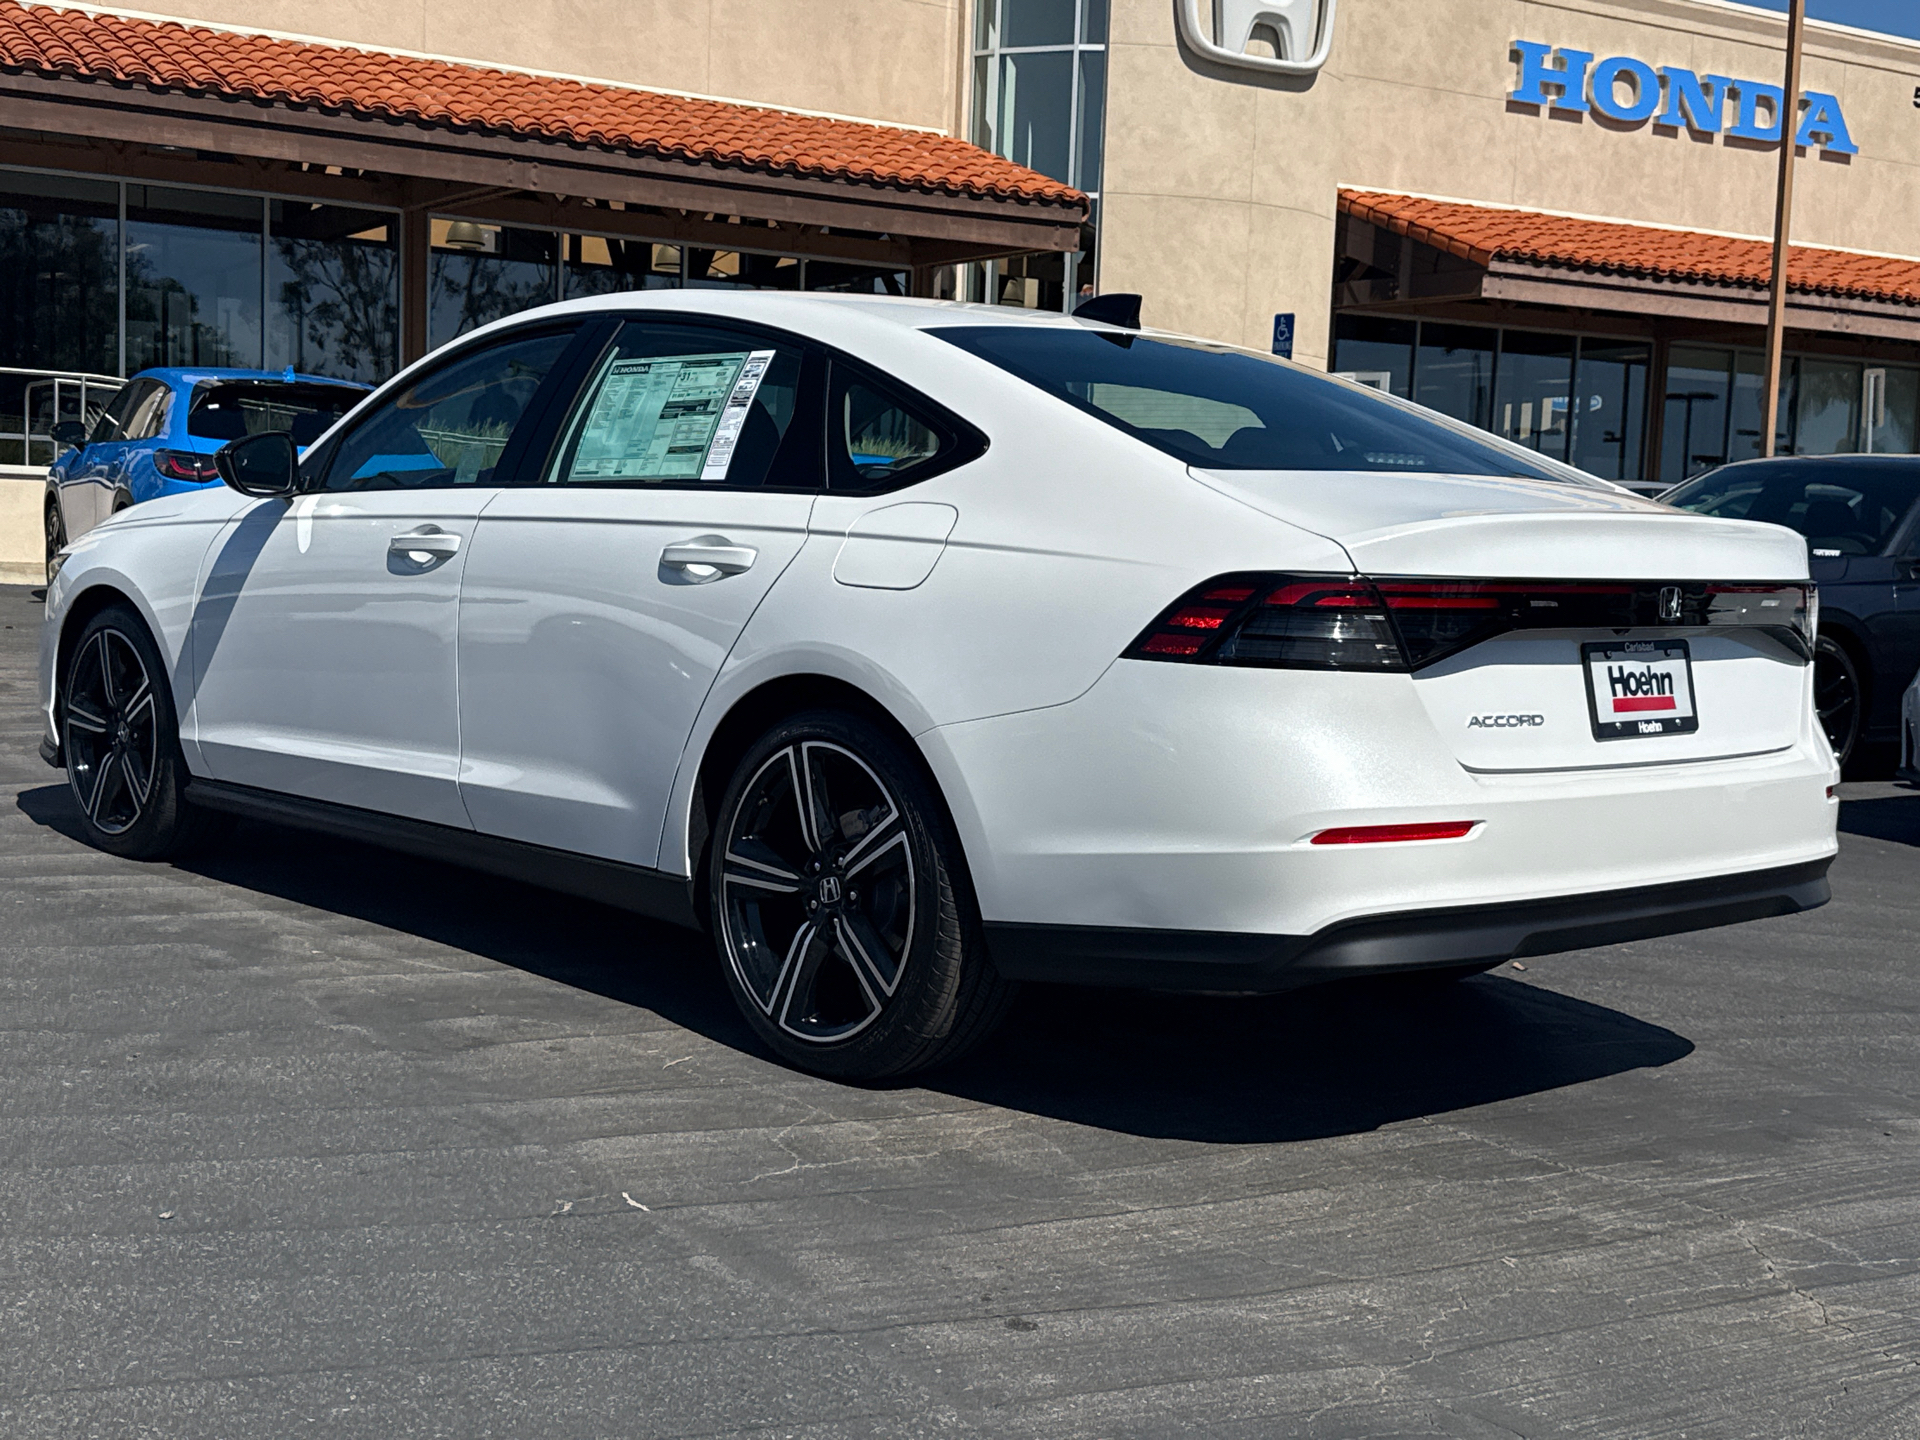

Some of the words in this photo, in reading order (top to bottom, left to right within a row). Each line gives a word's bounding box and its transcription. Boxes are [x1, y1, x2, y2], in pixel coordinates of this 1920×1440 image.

[1507, 39, 1859, 154] HONDA
[620, 365, 649, 373] HONDA
[1624, 642, 1655, 652] Carlsbad
[1607, 665, 1674, 697] Hoehn
[1467, 714, 1545, 729] ACCORD
[1638, 721, 1663, 733] Hoehn
